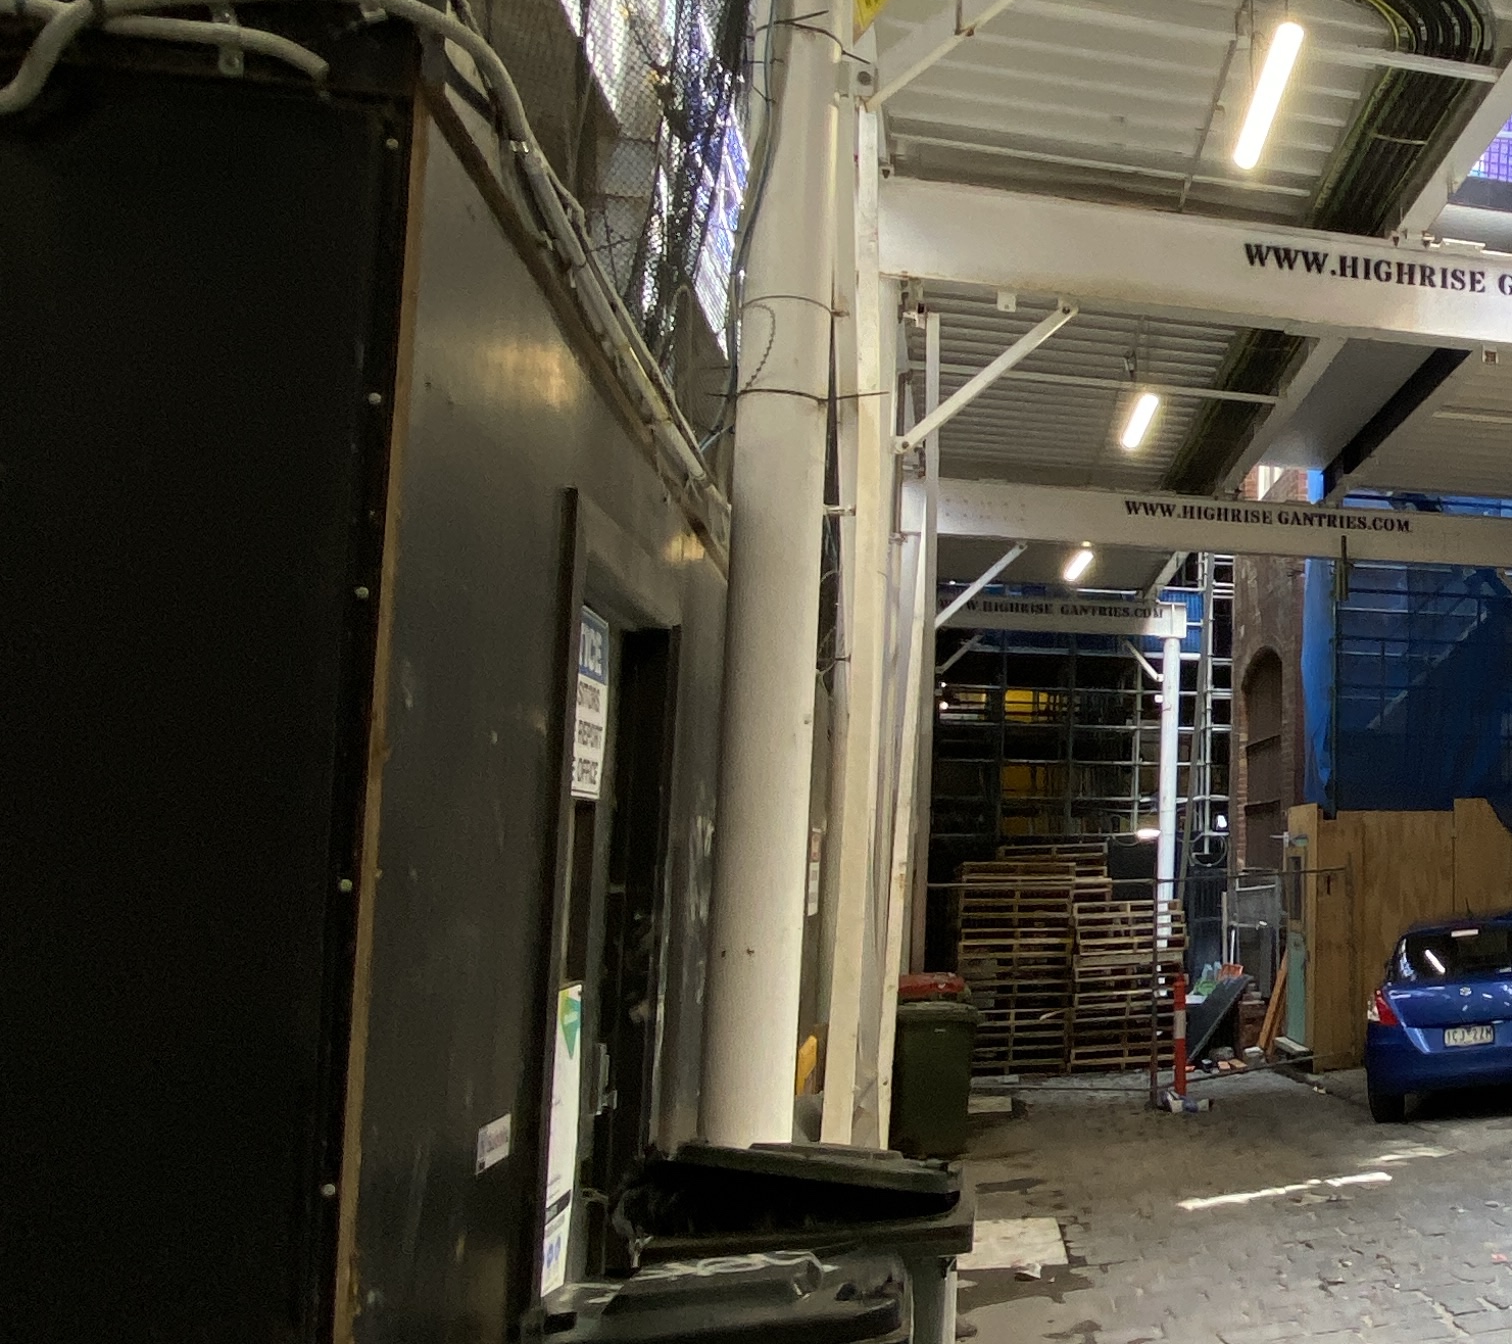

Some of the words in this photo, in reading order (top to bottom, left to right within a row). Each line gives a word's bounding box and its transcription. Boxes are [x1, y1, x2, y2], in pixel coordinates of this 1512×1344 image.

[1243, 243, 1486, 294] WWW.HIGHRISE
[1124, 500, 1273, 525] WWW.HIGHRISE
[1277, 509, 1412, 533] GANTRIES.COM
[940, 599, 1053, 615] WW.HIGHRISE
[1060, 603, 1163, 618] GANTRIES.COM
